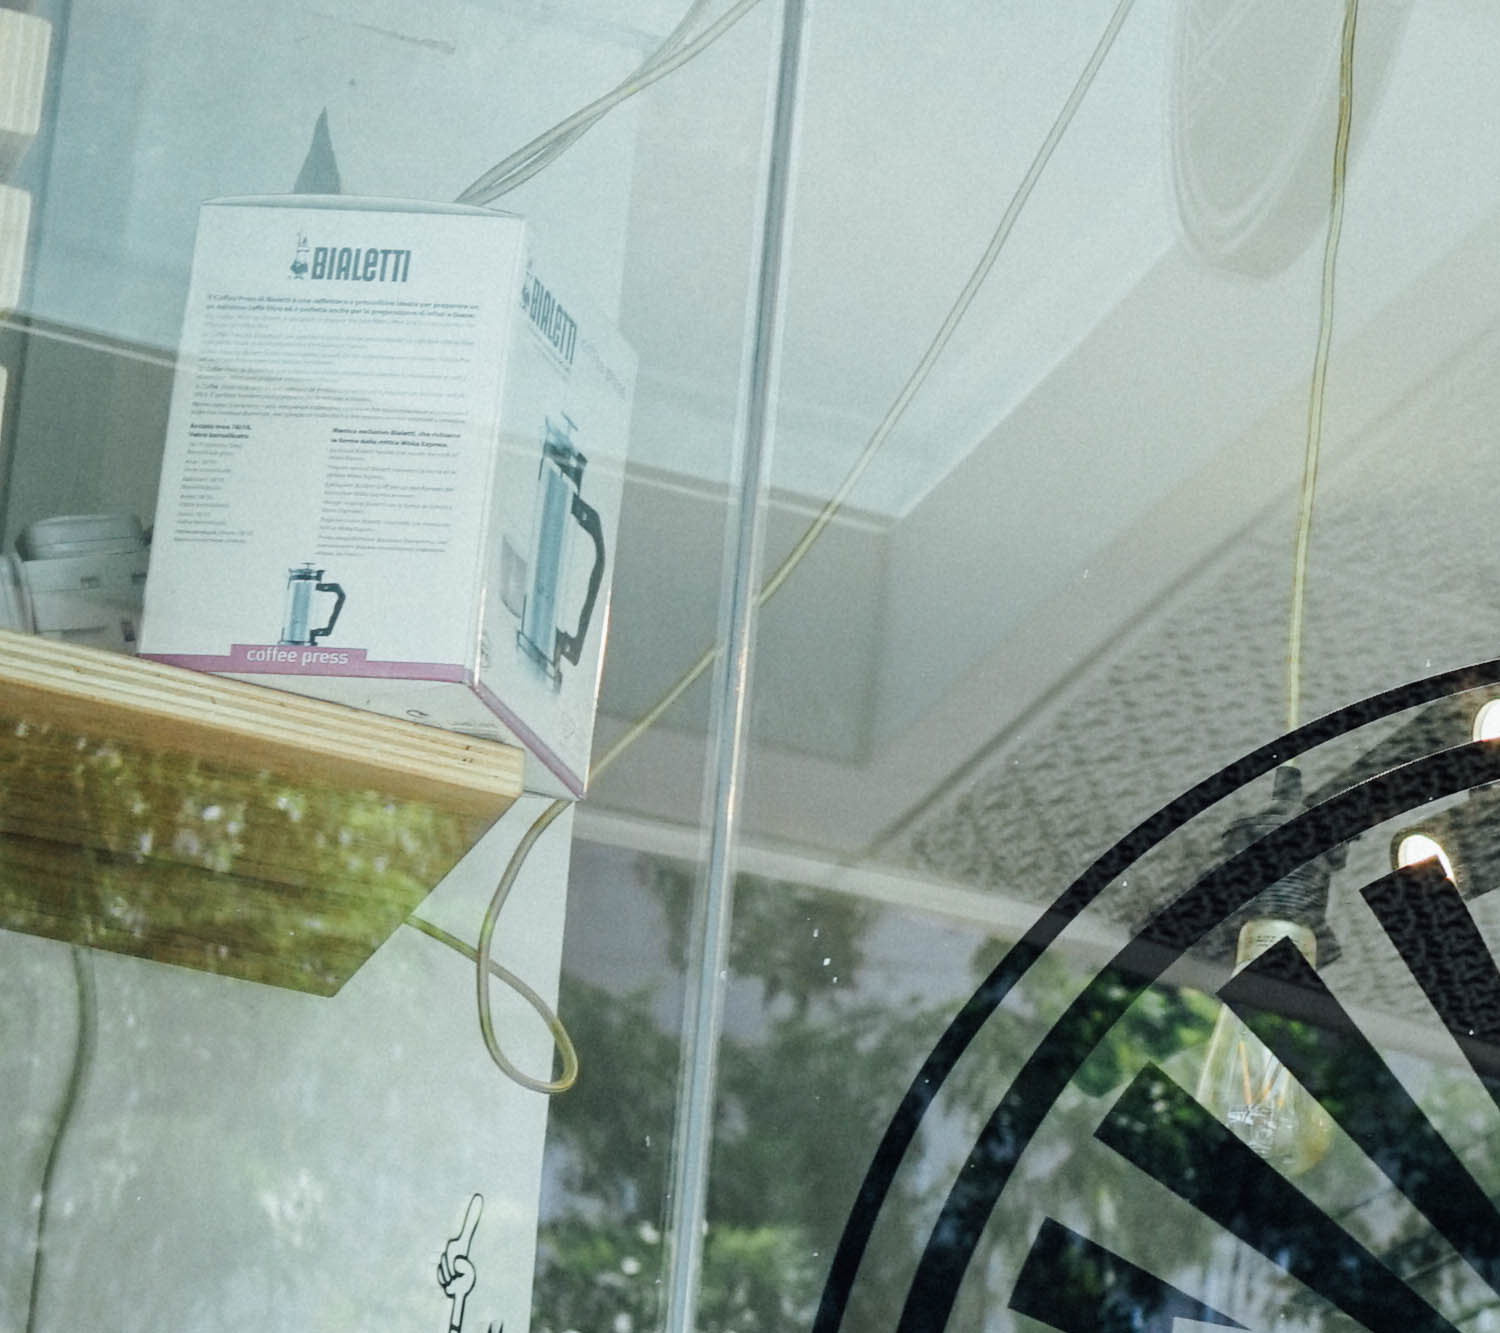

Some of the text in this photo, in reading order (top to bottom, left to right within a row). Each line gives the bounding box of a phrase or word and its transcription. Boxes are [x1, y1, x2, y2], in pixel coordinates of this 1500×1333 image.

[311, 247, 412, 283] BIALETTI
[247, 647, 349, 666] coffee press
